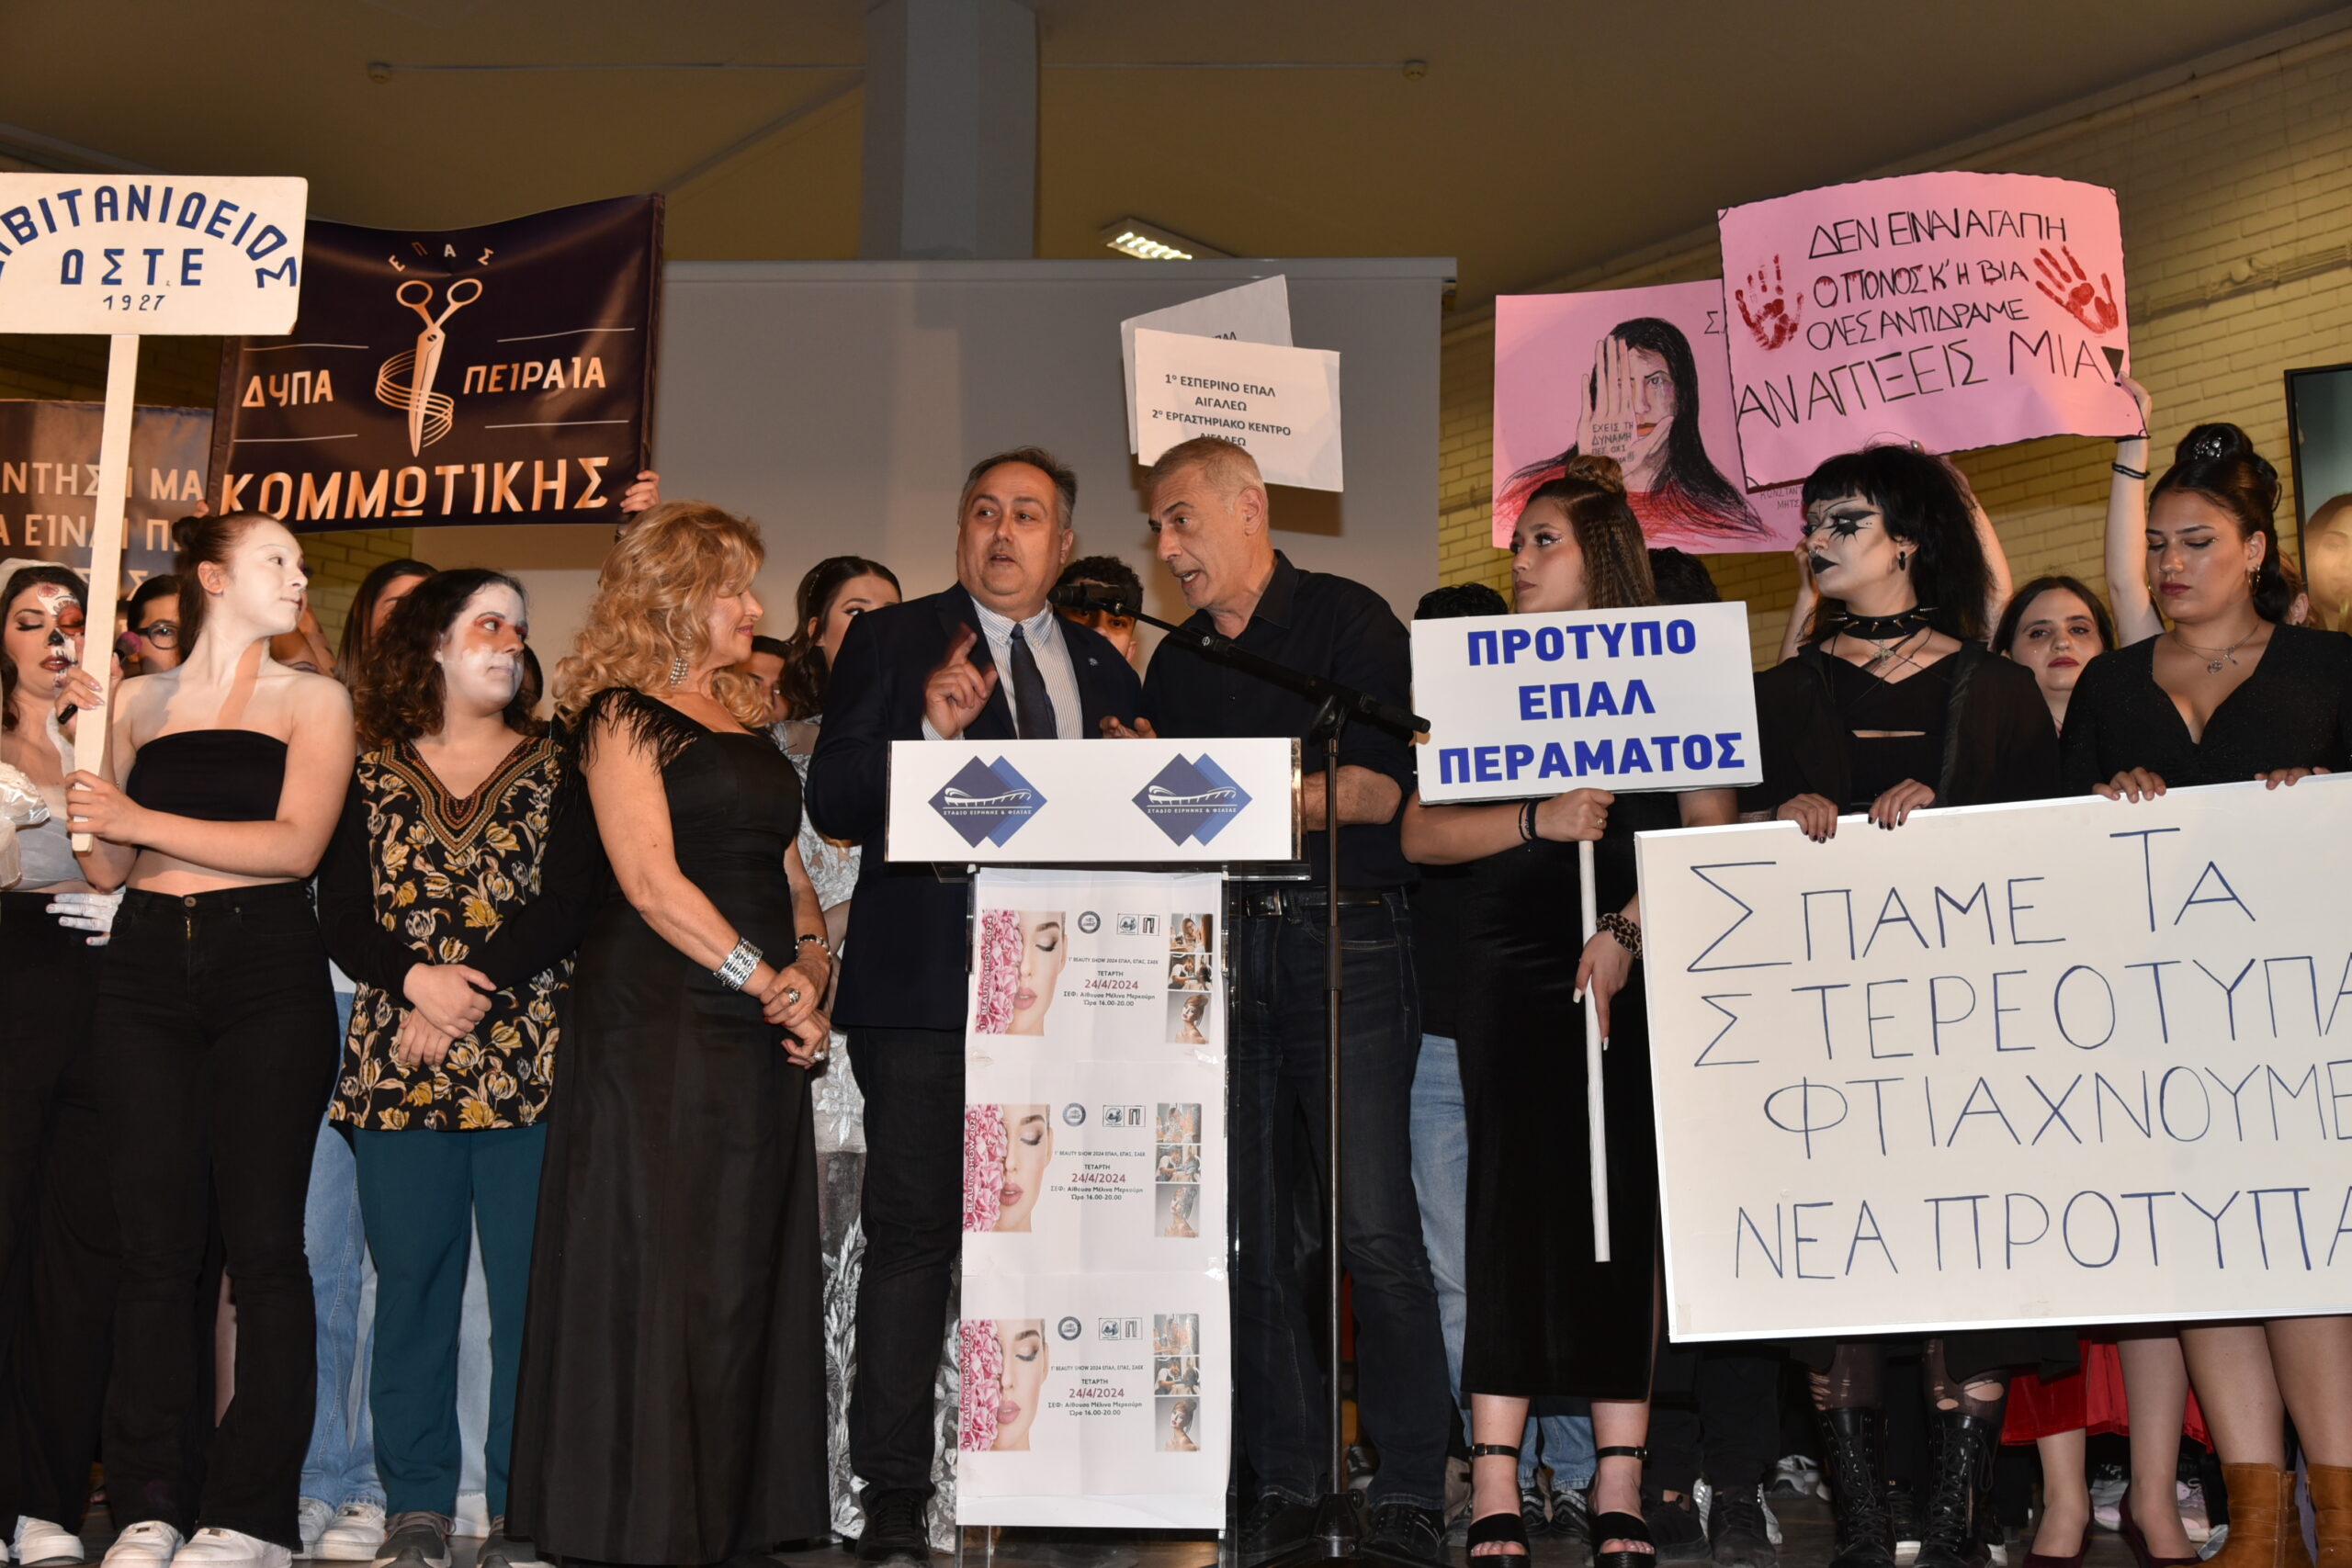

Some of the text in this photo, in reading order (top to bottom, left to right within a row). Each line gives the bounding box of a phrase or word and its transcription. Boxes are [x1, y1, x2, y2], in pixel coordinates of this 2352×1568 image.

[1809, 216, 1879, 259] ΔΕΝ
[1966, 209, 2067, 242] ΑΓΑΠΗ
[103, 294, 166, 310] 1927
[1814, 276, 1838, 308] Ο
[1840, 264, 1928, 303] ΠΟΝΟΣ
[1957, 263, 1970, 285] Η
[1976, 260, 2030, 284] ΒΙΑ
[1881, 299, 2030, 339] ΑΝΤΙΔΡΑΜΕ
[242, 369, 334, 408] ΔΥΠΑ
[462, 356, 606, 395] ΠΕΙΡΑΙΑ
[1181, 376, 1240, 392] ΕΣΠΕΡΙΝΟ
[1243, 384, 1276, 397] ΕΠΑΛ
[1195, 396, 1247, 412] ΑΙΓΑΛΕΩ
[1736, 374, 1799, 428] ΑΝ
[1166, 411, 1246, 430] ΕΡΓΑΣΤΗΡΙΑΚΟ
[1249, 422, 1291, 436] ΚΕΝΤΡΟ
[220, 457, 610, 521] ΚΟΜΜΩΤΙΚΗΣ
[1467, 619, 1696, 666] ΠΡΟΤΥΠΟ
[1519, 679, 1656, 720] ΕΠΑΛ
[1439, 732, 1745, 784] ΠΕΡΑΜΑΤΟΣ
[1687, 827, 2256, 972] ΣΠΑΜΕ ΤΑ
[984, 942, 992, 976] SHOW
[981, 978, 989, 1015] BEAUTY
[1084, 979, 1139, 989] 24/4/2024
[1763, 1059, 2352, 1159] ΦΤΙΑΧΝΟΥΜΕ
[1071, 1173, 1125, 1183] 24/4/2024
[1736, 1200, 1899, 1280] ΝΕΑ
[1069, 1388, 1125, 1399] 24/4/2024
